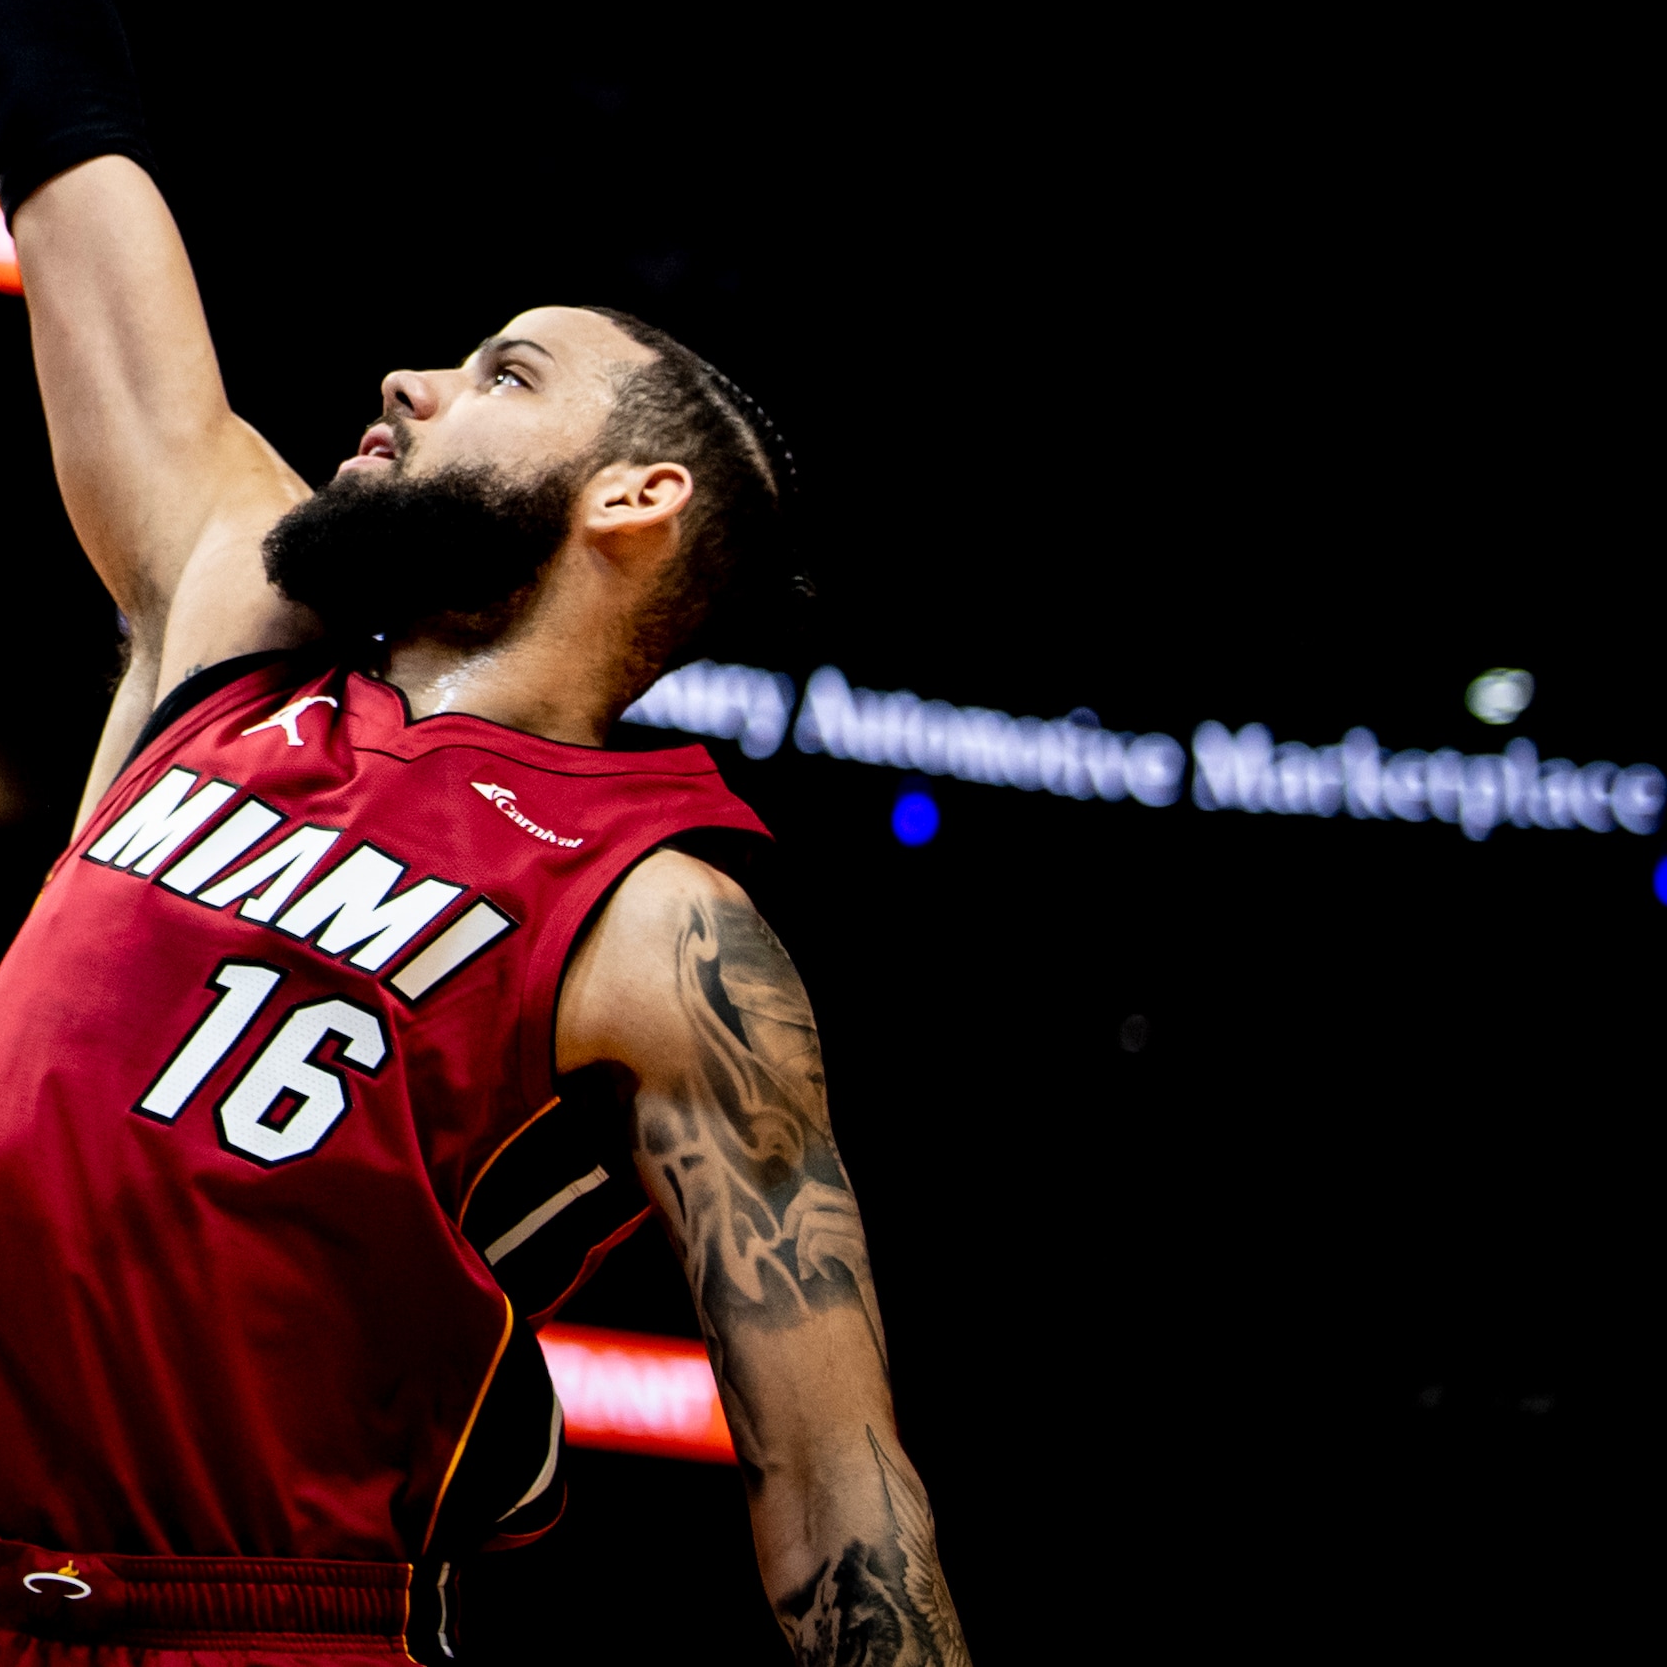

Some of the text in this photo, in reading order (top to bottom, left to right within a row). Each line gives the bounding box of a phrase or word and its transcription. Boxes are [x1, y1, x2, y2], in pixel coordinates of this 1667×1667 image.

[79, 764, 521, 1006] MIAMI
[495, 797, 584, 849] Carnival
[130, 956, 395, 1167] 16
